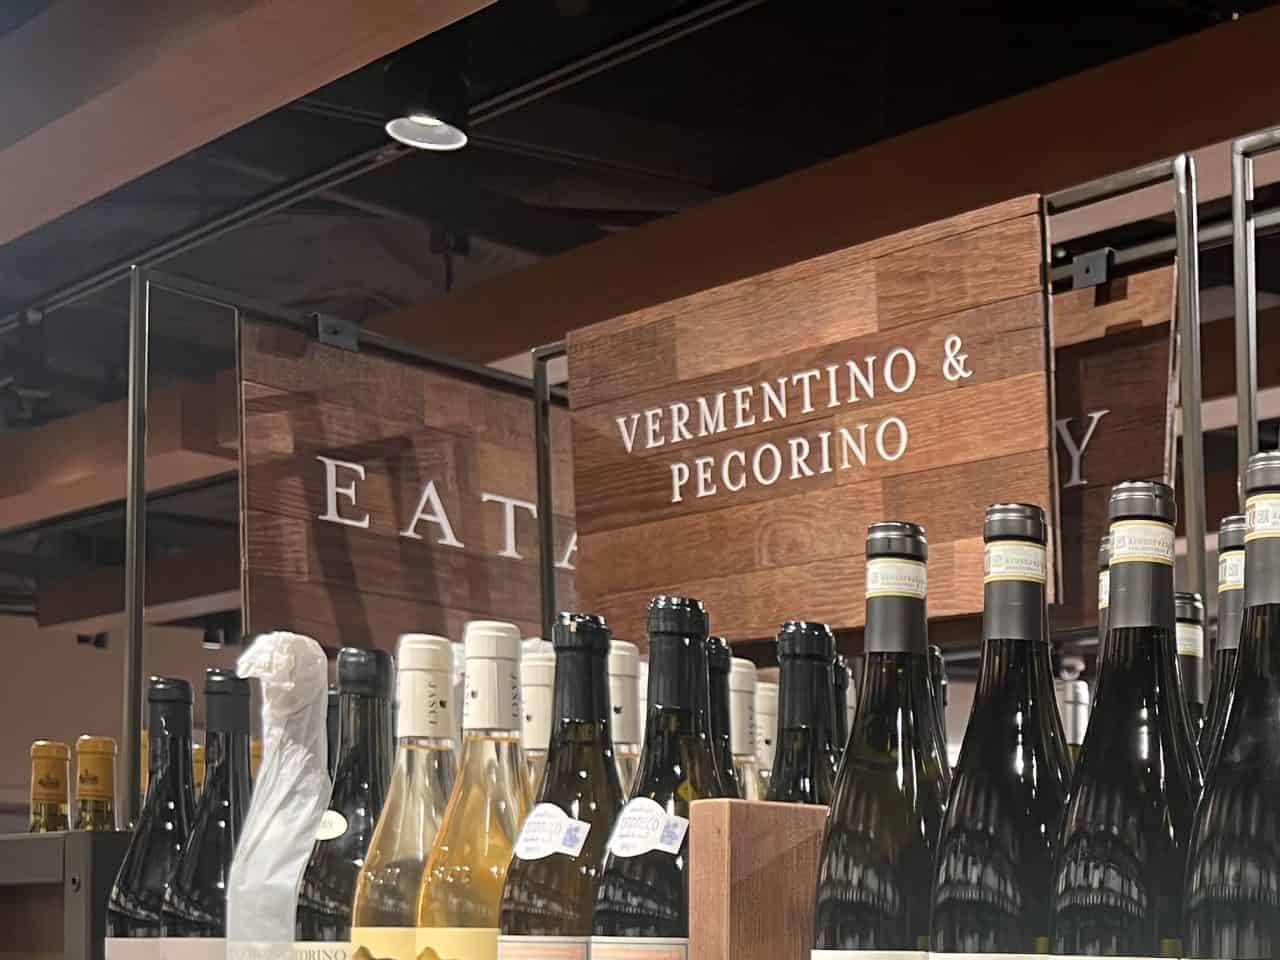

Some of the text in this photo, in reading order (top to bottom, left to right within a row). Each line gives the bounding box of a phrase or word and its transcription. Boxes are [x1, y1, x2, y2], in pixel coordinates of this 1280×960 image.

[615, 335, 973, 454] VERMENTINO &
[669, 416, 910, 503] PECORINO
